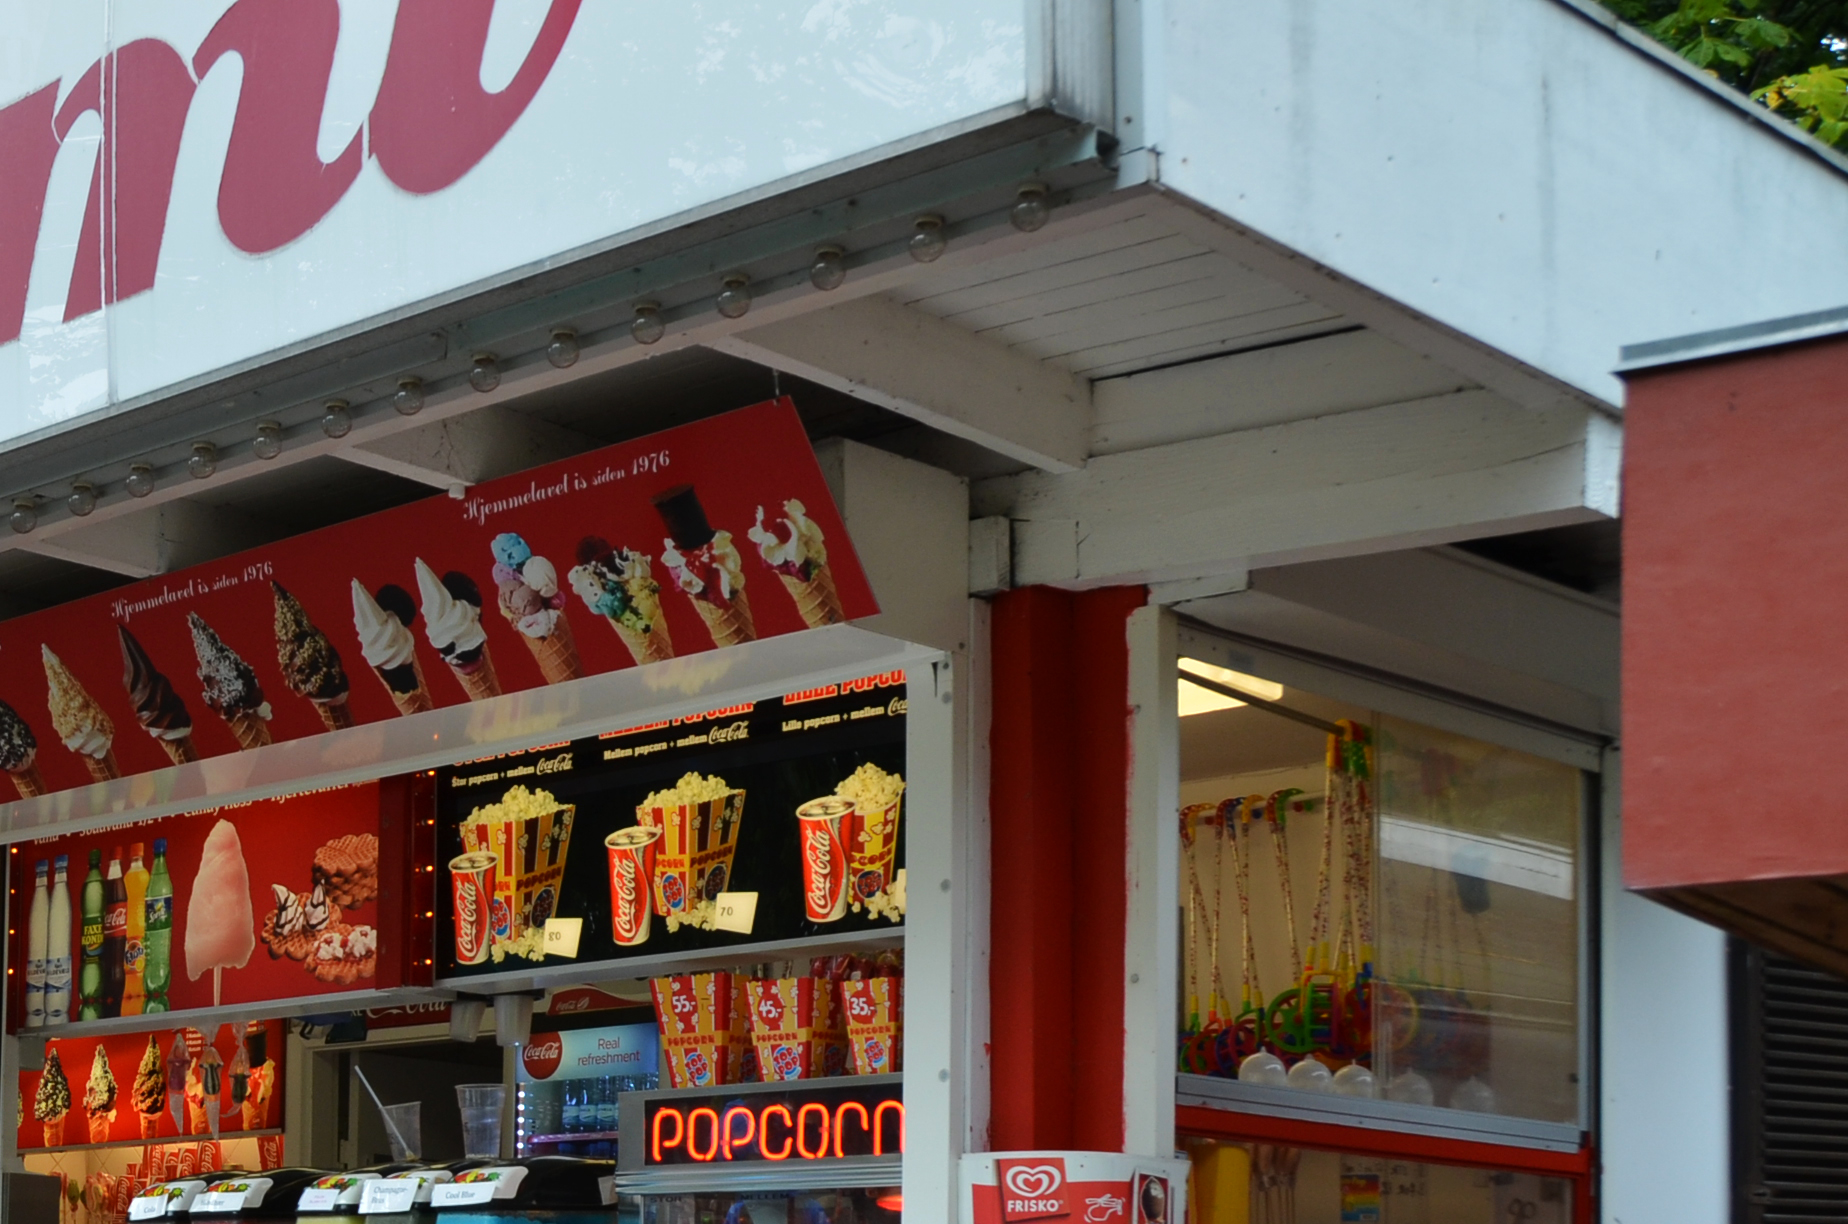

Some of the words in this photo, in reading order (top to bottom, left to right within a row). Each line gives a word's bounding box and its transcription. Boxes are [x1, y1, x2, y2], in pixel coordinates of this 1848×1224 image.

[574, 472, 587, 491] is
[592, 466, 626, 487] siden
[631, 449, 671, 475] 1976
[212, 574, 239, 592] siden
[241, 560, 274, 583] 1976
[803, 711, 841, 731] popcorn
[850, 705, 885, 720] mellem
[634, 741, 667, 759] popcorn
[677, 733, 708, 749] mellem
[719, 905, 734, 917] 70
[84, 924, 103, 936] FAXE
[756, 1031, 799, 1043] POPCORN
[850, 1025, 893, 1036] POPCORN
[597, 1037, 621, 1051] Real
[667, 1034, 716, 1048] POPCORN
[523, 1041, 561, 1062] Coca-Cola
[577, 1050, 641, 1067] refreshment
[446, 1191, 461, 1200] Cool
[462, 1190, 476, 1200] Blue
[1007, 1199, 1060, 1213] FRISKO
